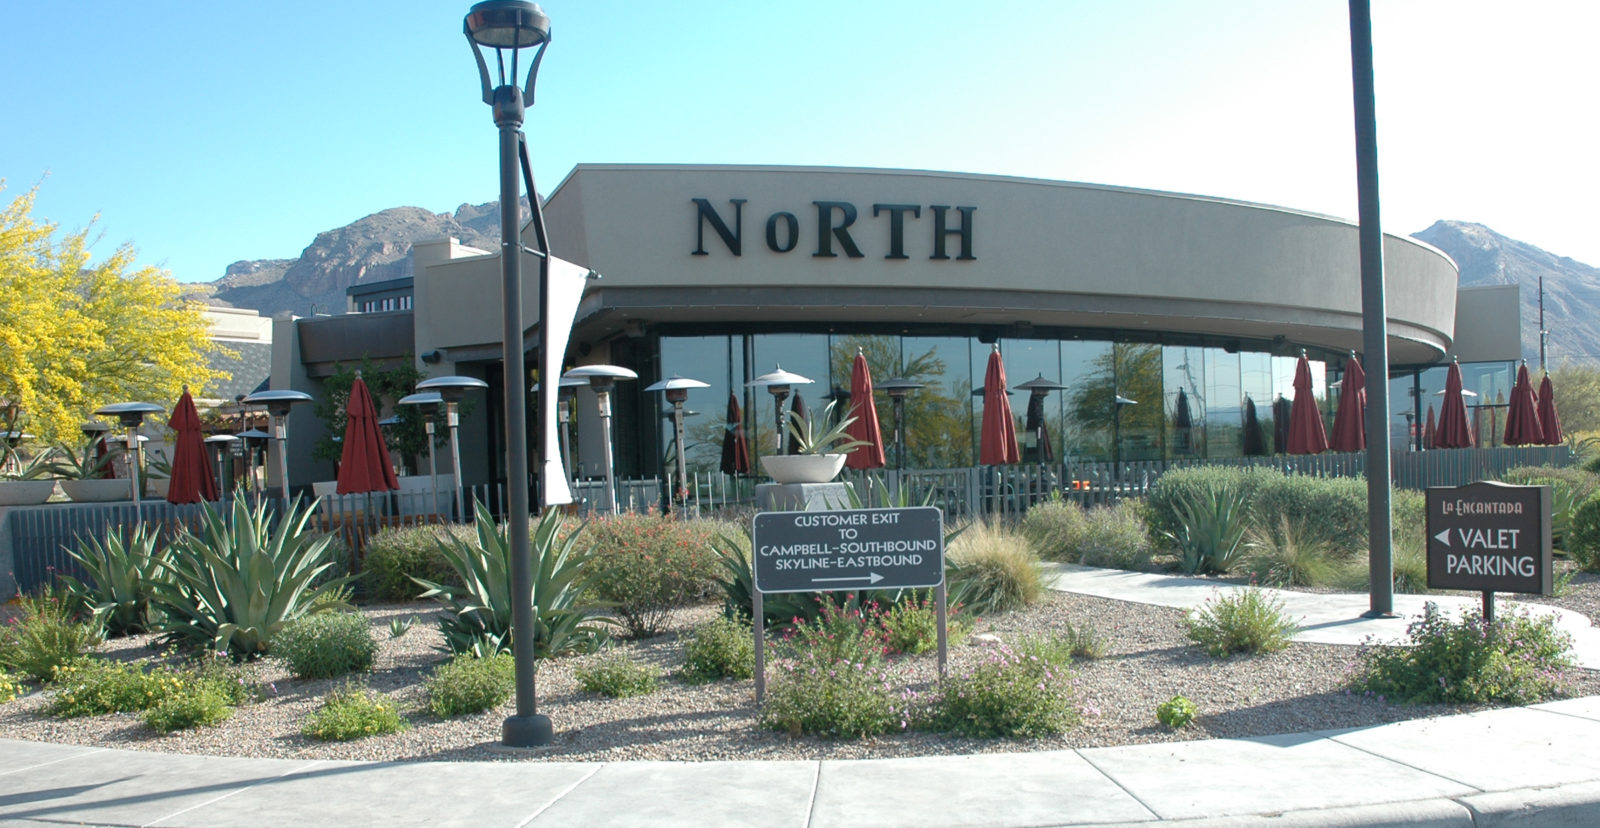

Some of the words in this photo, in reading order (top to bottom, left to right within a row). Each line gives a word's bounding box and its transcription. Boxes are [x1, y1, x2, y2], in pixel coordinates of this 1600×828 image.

[794, 514, 868, 527] CUSTOMER
[872, 513, 900, 524] EXIT
[838, 528, 858, 540] TO
[1458, 528, 1520, 549] VALET
[760, 540, 937, 557] CAMPBELL-SOUTHBOUND
[775, 555, 923, 570] SKYLINE-EASTBOUND
[1447, 554, 1535, 577] PARKING
